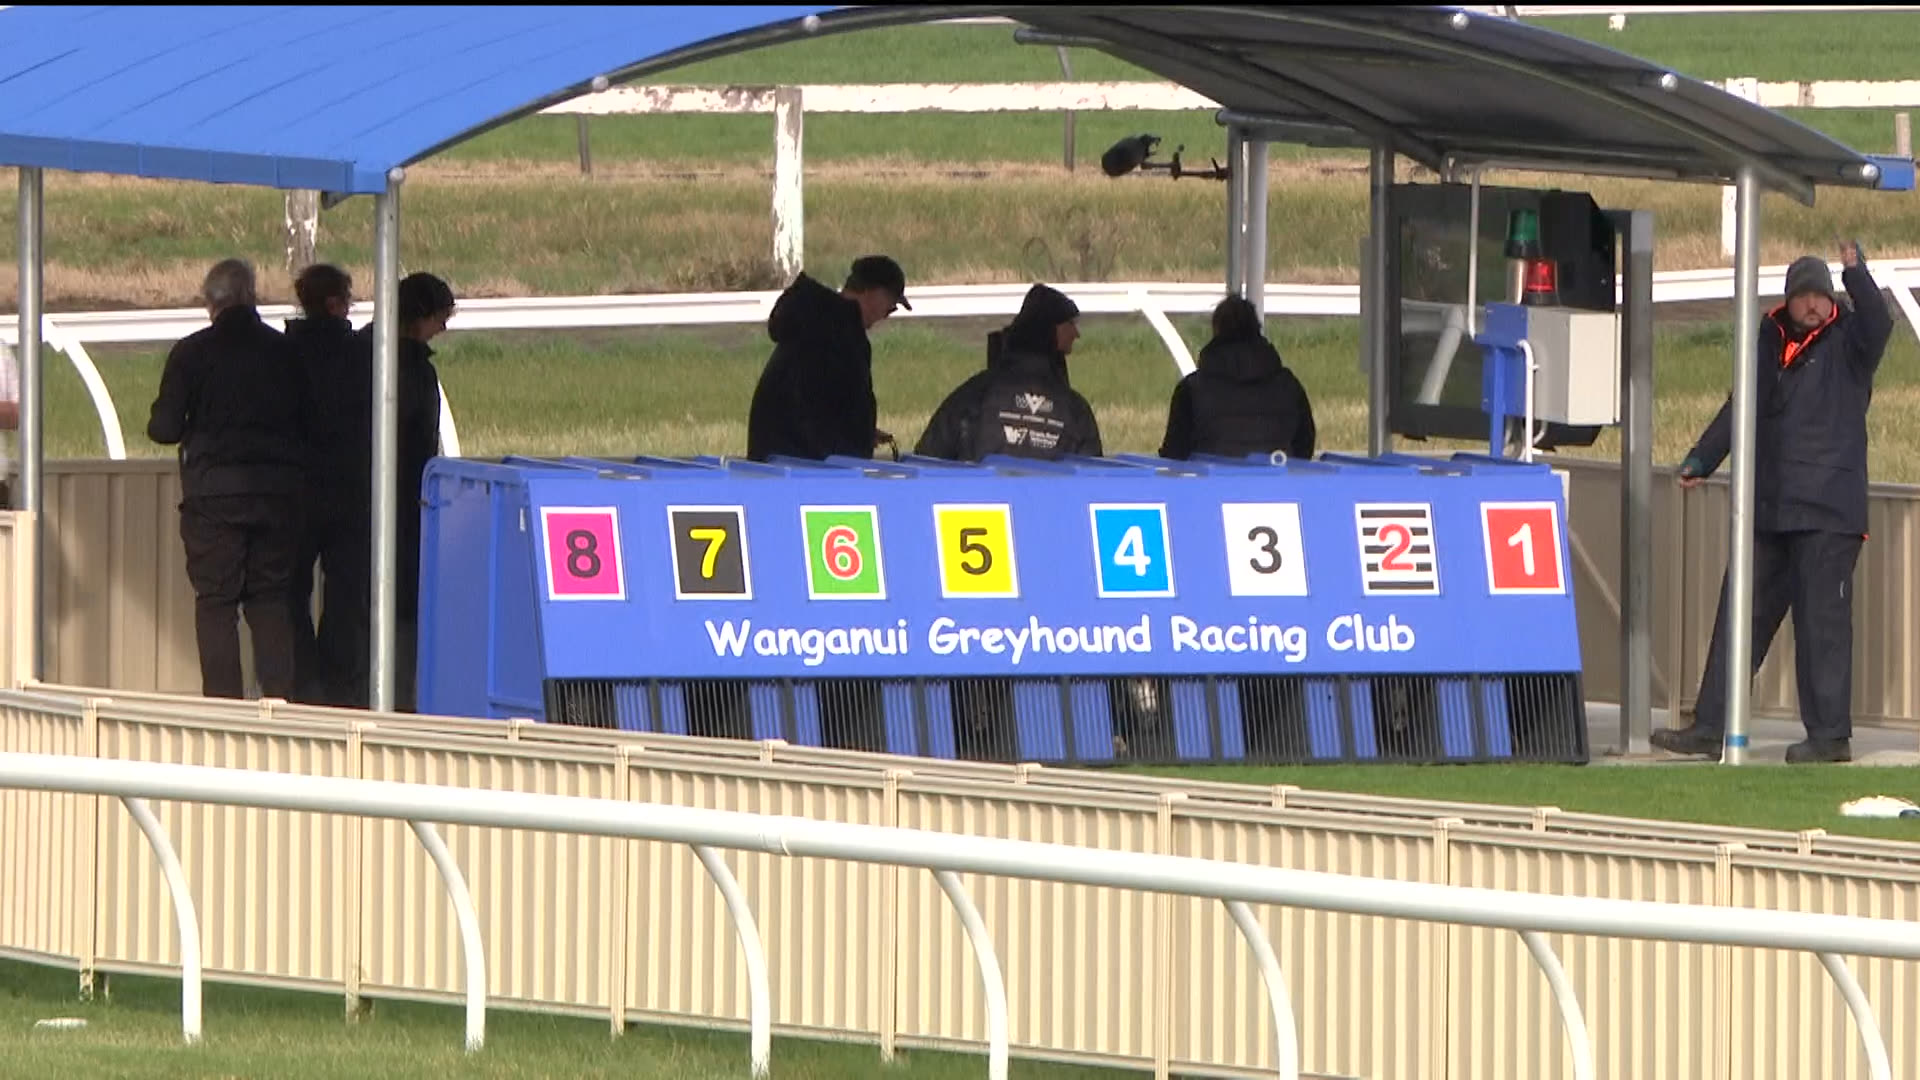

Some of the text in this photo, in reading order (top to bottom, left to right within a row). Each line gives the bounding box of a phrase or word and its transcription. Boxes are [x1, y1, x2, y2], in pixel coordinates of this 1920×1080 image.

[566, 529, 600, 578] 8
[690, 527, 726, 578] 7
[823, 525, 863, 579] 6
[960, 527, 992, 575] 5
[1114, 525, 1151, 576] 4
[1247, 526, 1282, 574] 3
[1379, 524, 1414, 571] 2
[1508, 523, 1535, 575] 1
[705, 615, 1415, 666] Wanganui Greyhound Racing Club
